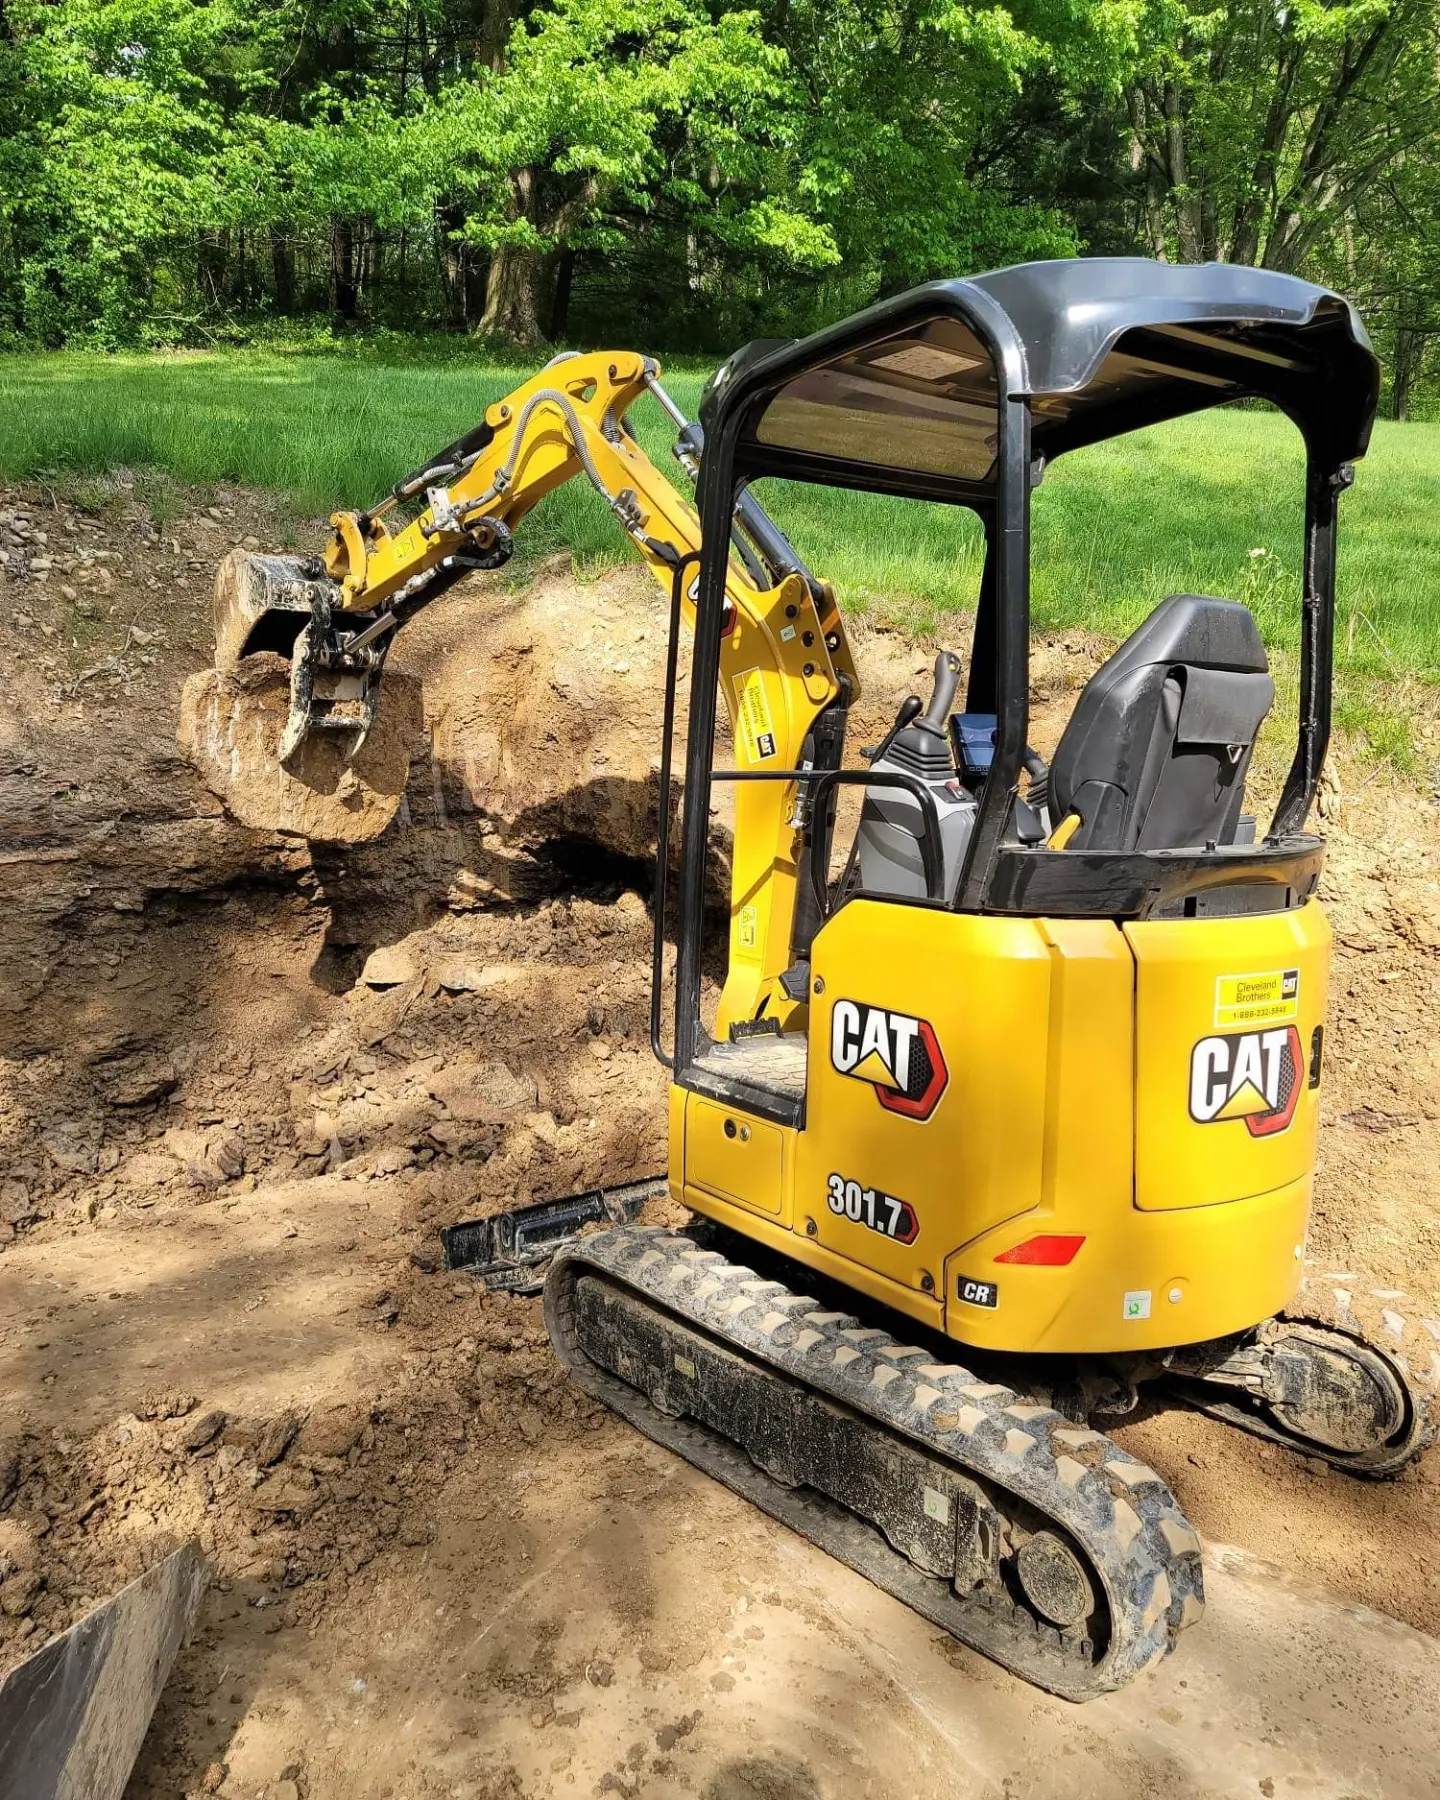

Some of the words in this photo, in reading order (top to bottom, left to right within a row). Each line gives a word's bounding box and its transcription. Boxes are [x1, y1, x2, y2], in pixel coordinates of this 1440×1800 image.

[760, 735, 773, 754] CAT
[1237, 979, 1277, 992] Cleveland
[1235, 991, 1271, 1003] Brothers
[831, 999, 919, 1092] CAT
[1190, 1028, 1288, 1120] CAT
[828, 1174, 902, 1237] 301.7
[963, 1282, 990, 1303] CR
